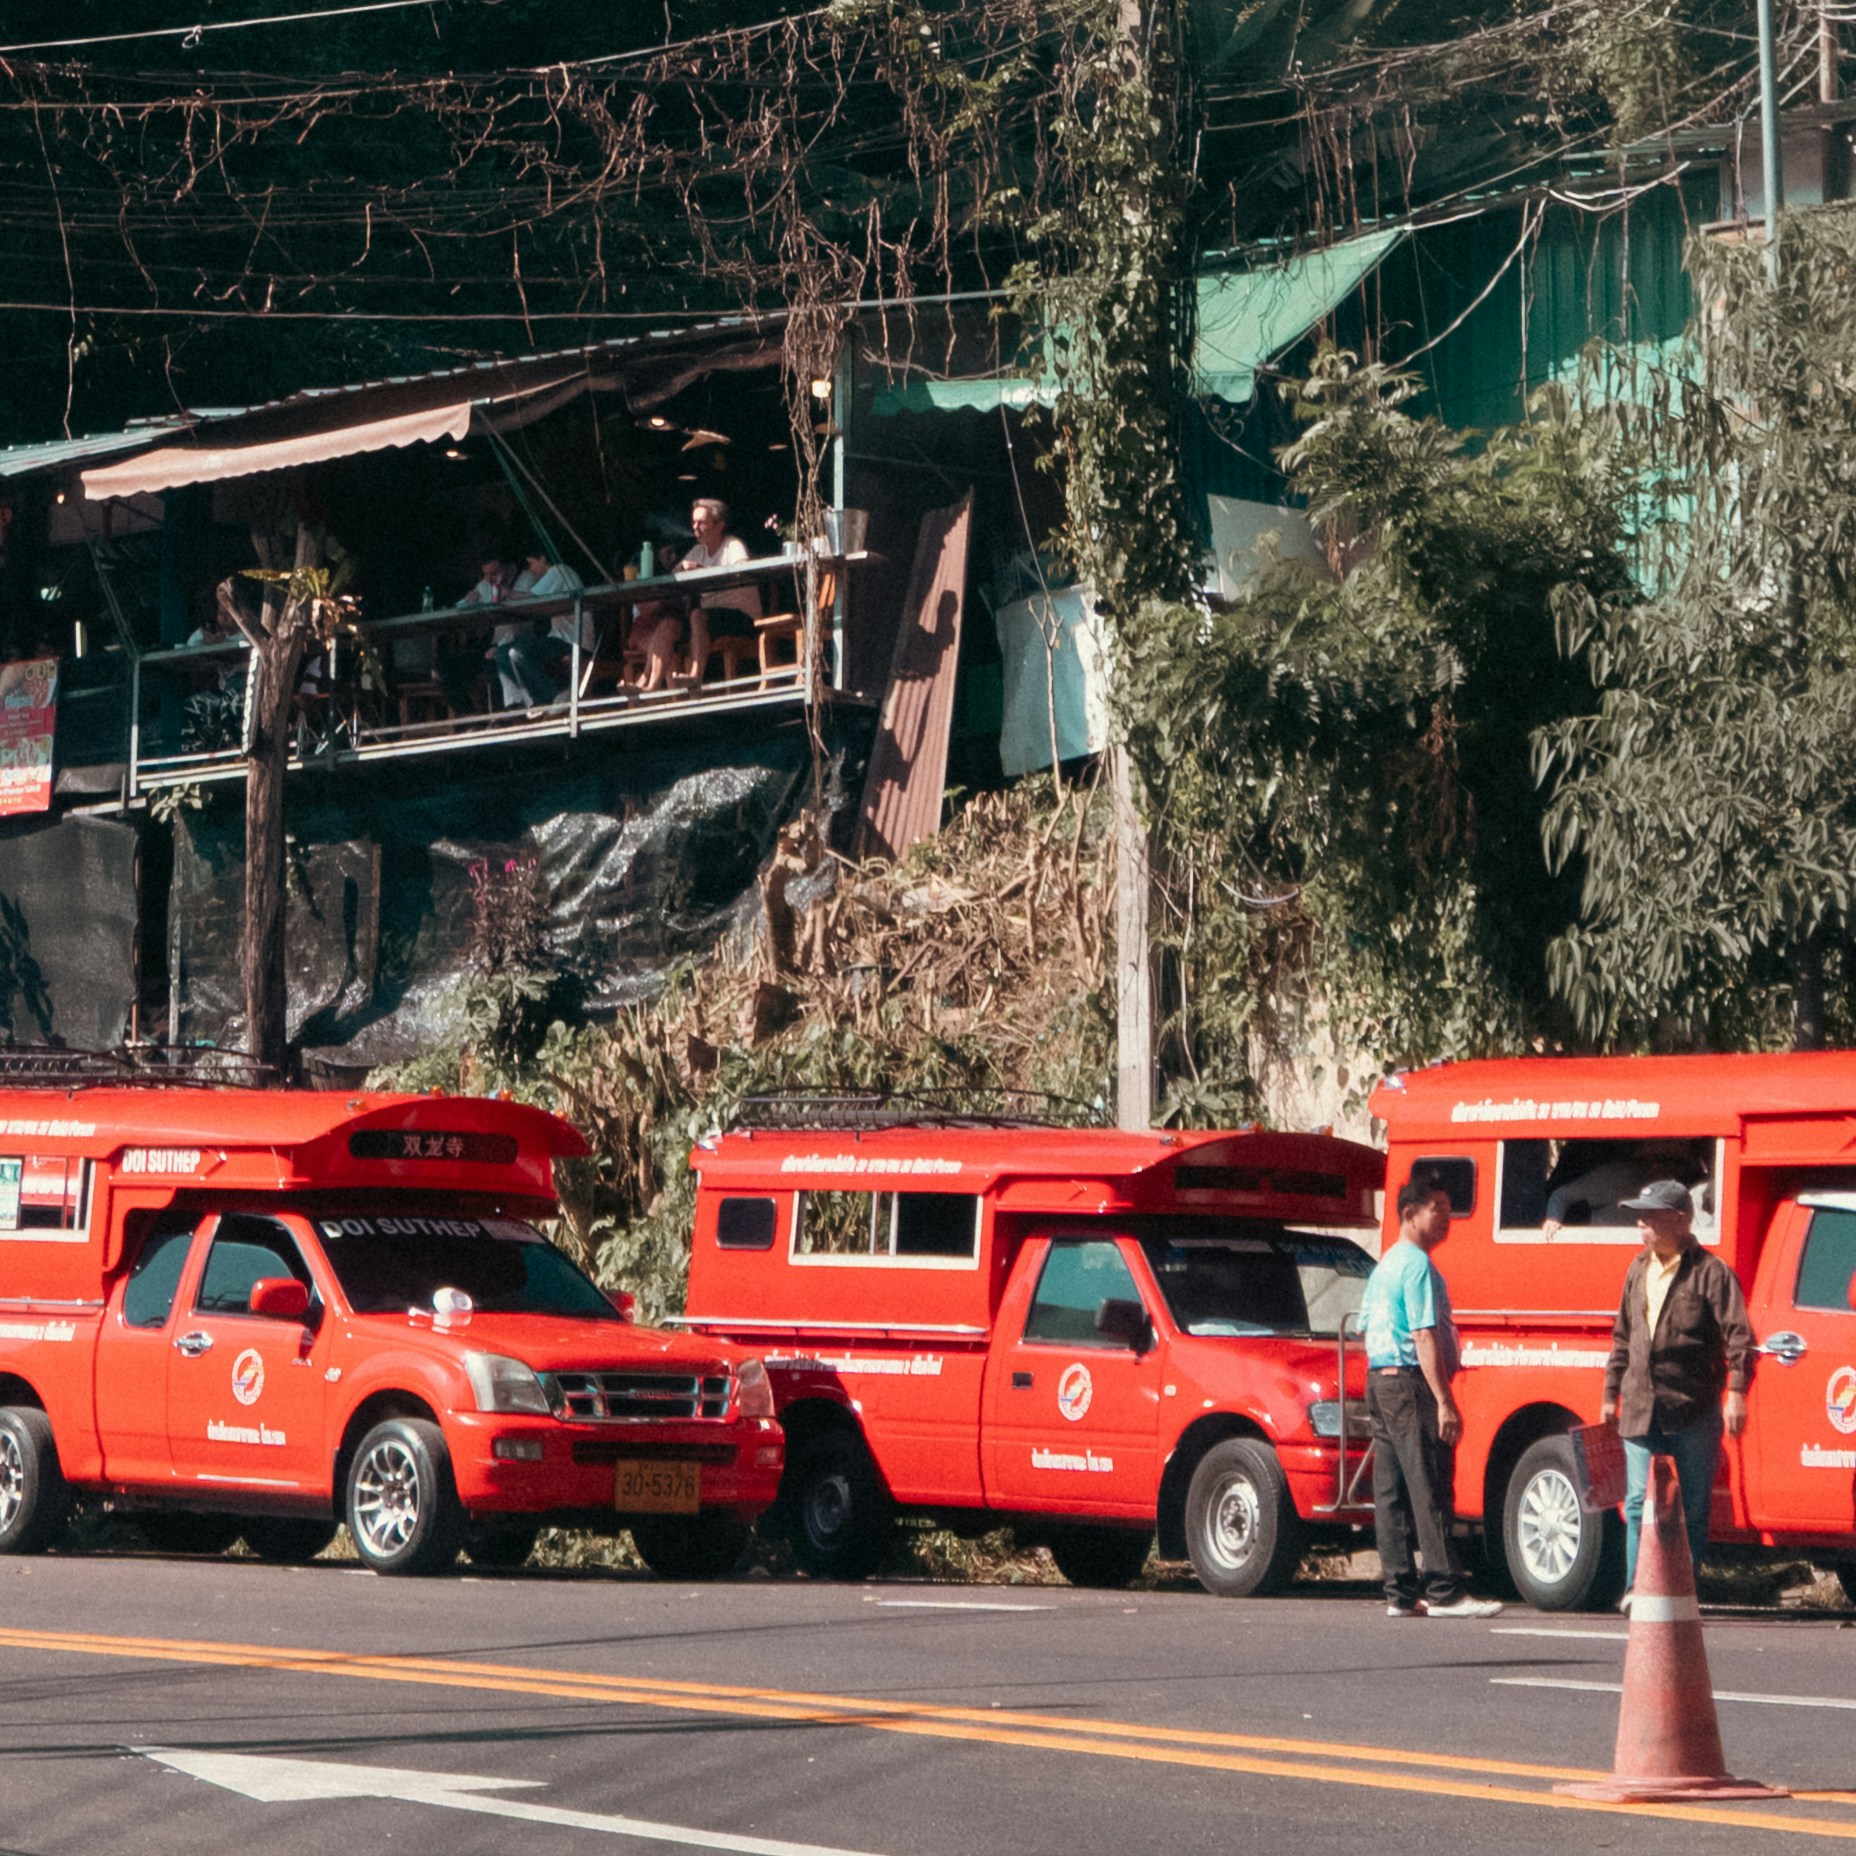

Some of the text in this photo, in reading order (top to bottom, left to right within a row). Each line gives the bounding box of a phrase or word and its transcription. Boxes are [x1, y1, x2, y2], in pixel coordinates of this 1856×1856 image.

[402, 1134, 465, 1159] 双龙寺
[121, 1149, 201, 1173] DOI SUTHEP
[319, 1217, 482, 1239] DOI SUTHEP
